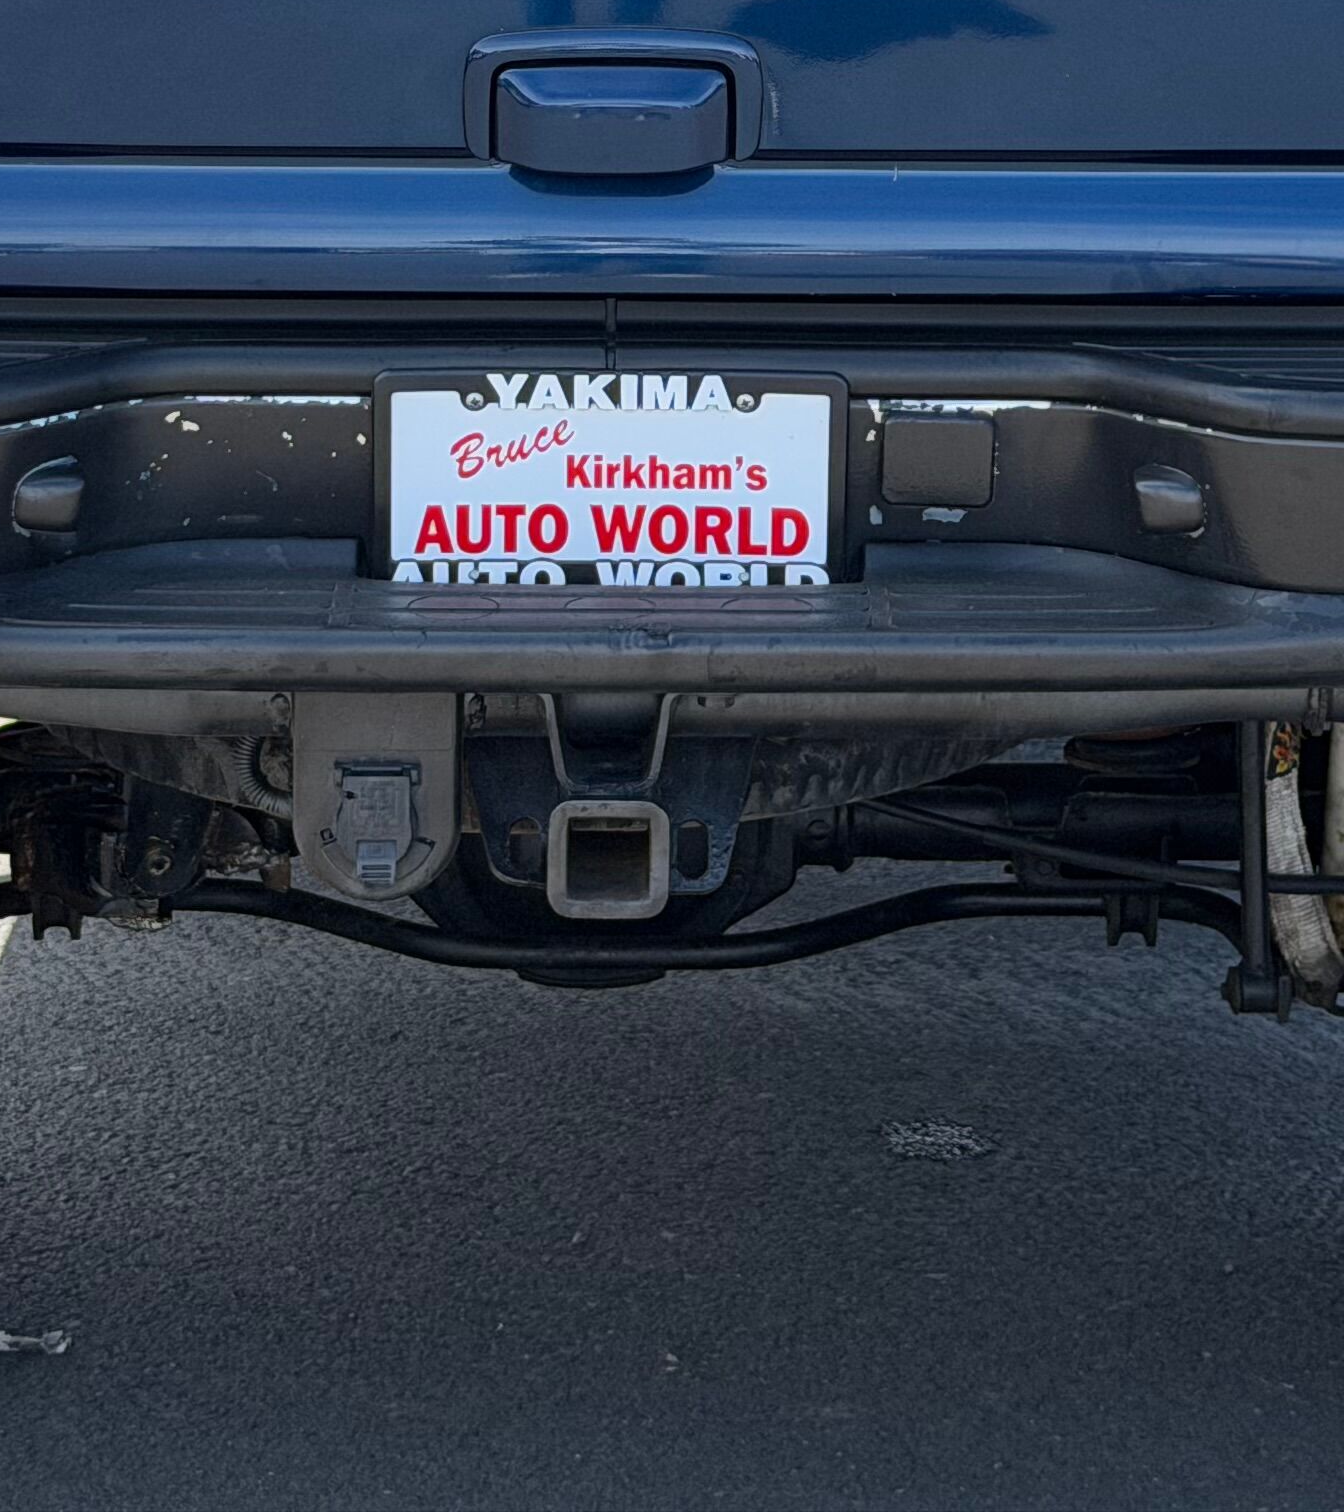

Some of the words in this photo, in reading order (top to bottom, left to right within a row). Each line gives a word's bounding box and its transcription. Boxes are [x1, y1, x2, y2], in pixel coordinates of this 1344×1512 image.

[486, 373, 733, 410] YAKIMA
[450, 418, 575, 480] Bruce
[565, 454, 769, 491] Kirkham's
[414, 503, 570, 555] AUTO
[590, 503, 811, 557] WORLD
